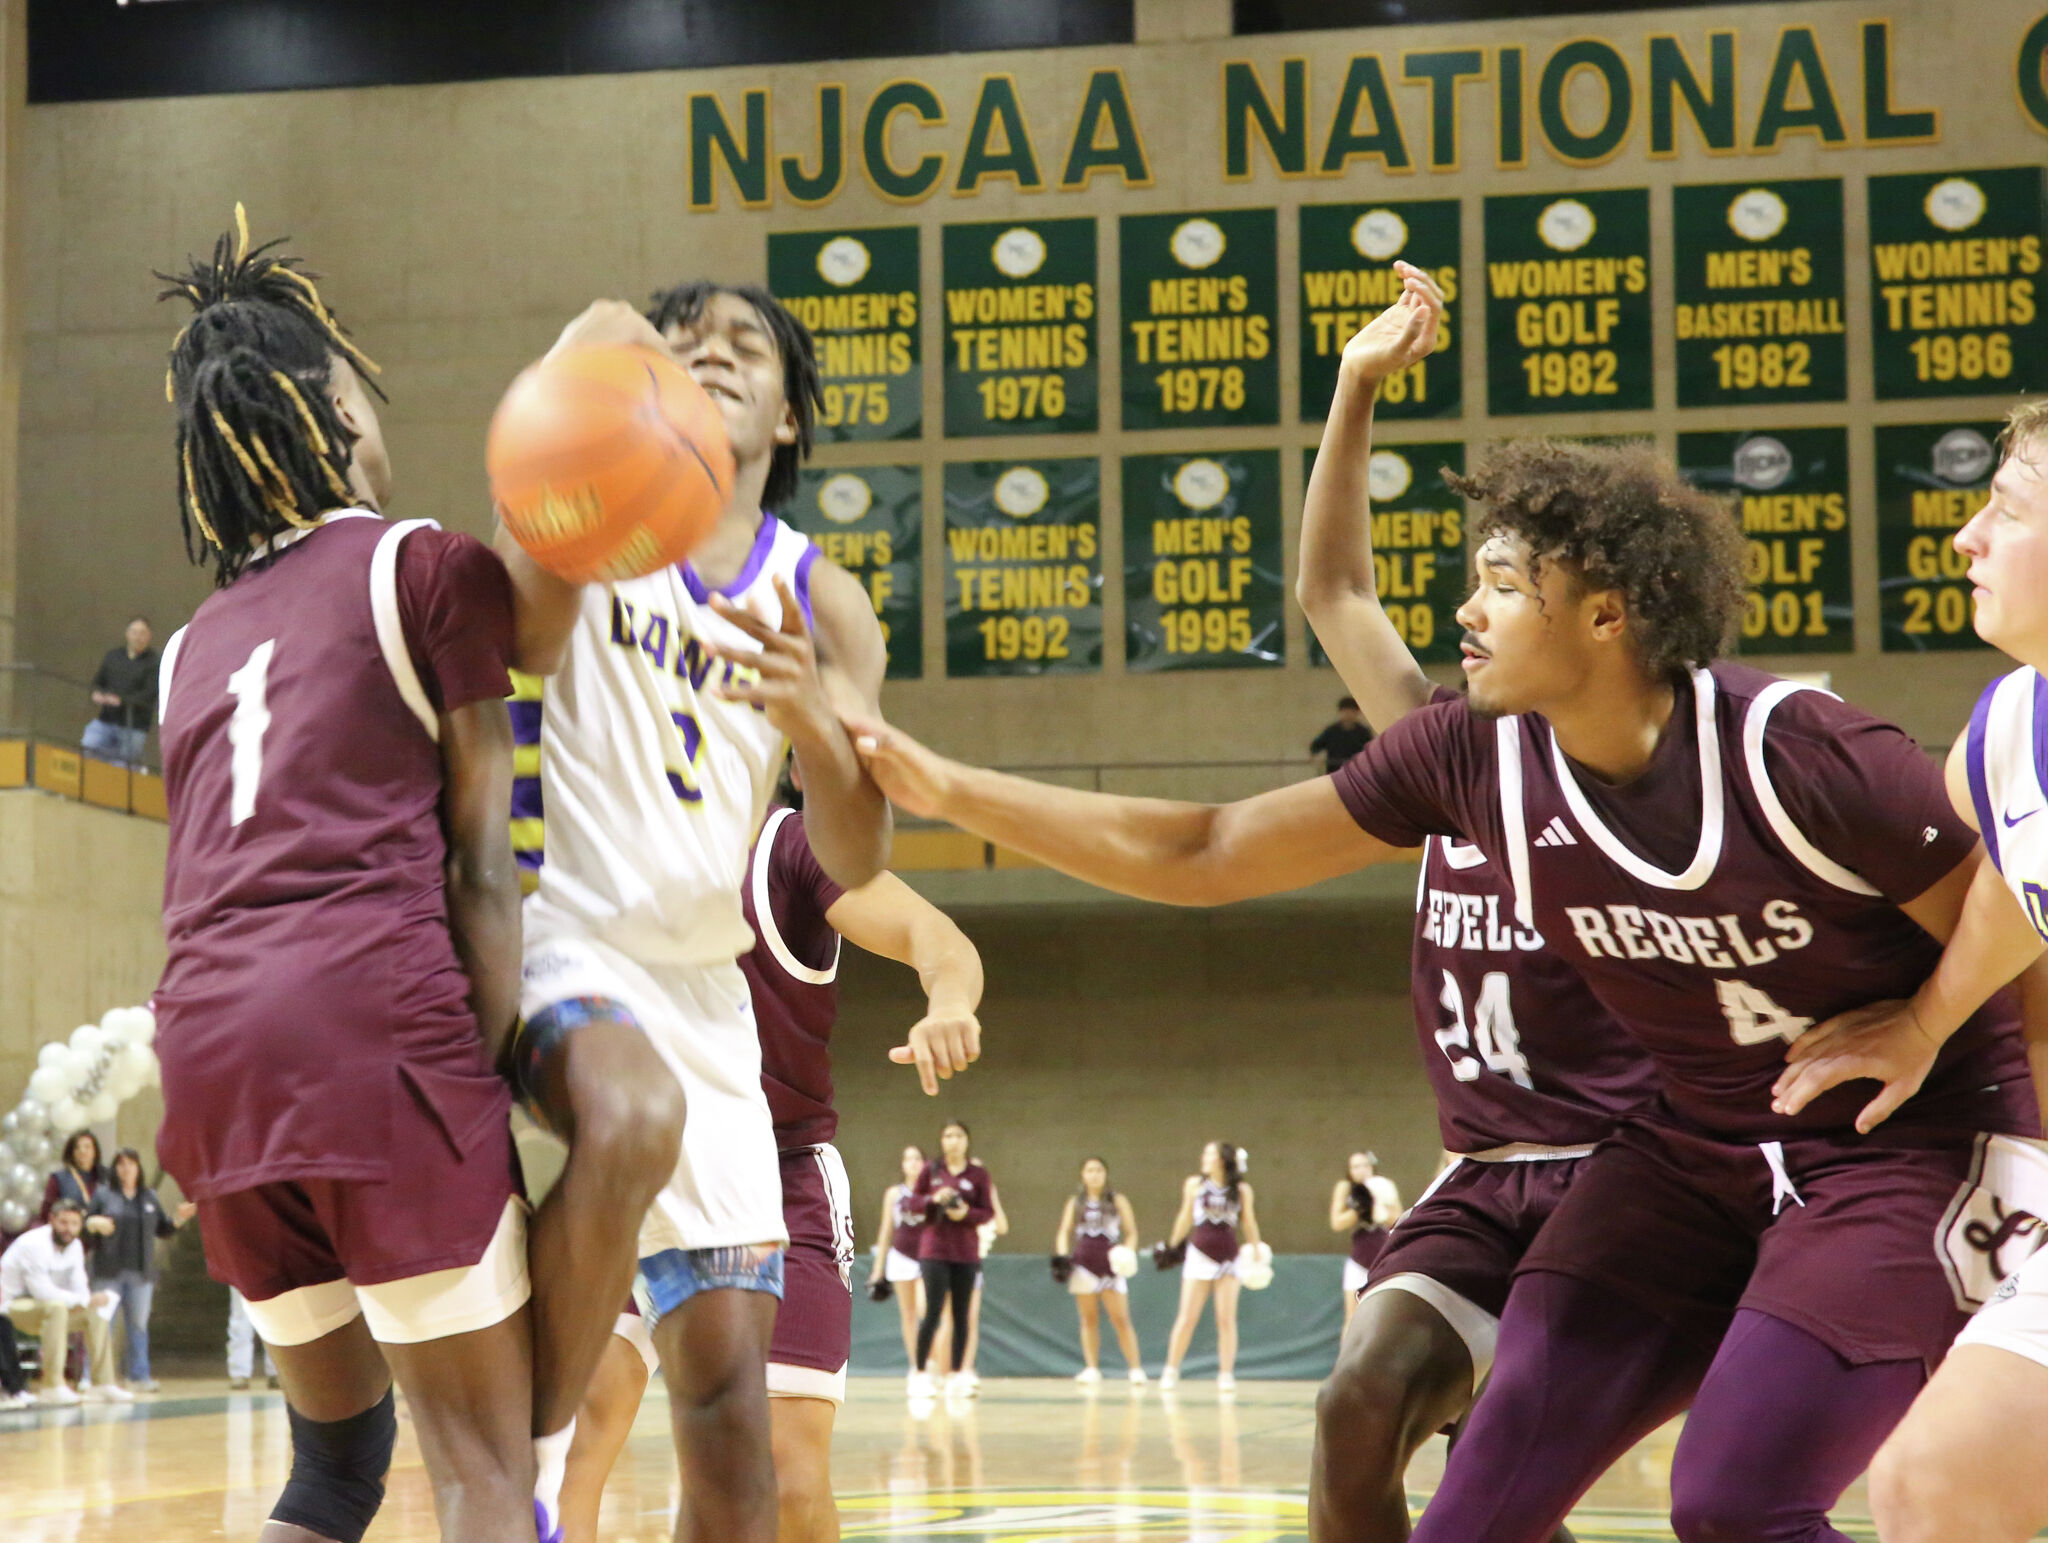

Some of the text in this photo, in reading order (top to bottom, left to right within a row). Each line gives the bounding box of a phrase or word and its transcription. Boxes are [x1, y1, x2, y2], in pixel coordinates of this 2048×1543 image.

[687, 66, 1155, 212] NJCAA
[1221, 18, 1942, 182] NATIONAL
[1489, 256, 1646, 298] WOMEN'S
[1706, 248, 1811, 288] MEN'S
[1875, 236, 2041, 281] WOMEN'S
[946, 283, 1094, 327] WOMEN'S
[1150, 275, 1248, 315] MEN'S
[1304, 266, 1457, 307] WOMES
[1881, 279, 2035, 330] TENNIS
[1131, 315, 1270, 364] TENNIS
[1516, 299, 1619, 347] GOLF
[1674, 299, 1844, 339] BASKETBALL
[952, 323, 1087, 372] TENNIS
[1713, 342, 1810, 389] 1982
[1910, 333, 2012, 381] 1986
[1156, 366, 1245, 412] 1978
[1522, 350, 1617, 397] 1982
[978, 374, 1066, 420] 1976
[1153, 516, 1251, 555] MEN'S
[1369, 509, 1462, 548] MEN'S
[1741, 493, 1845, 532] MEN'S
[948, 522, 1097, 561] WOMEN'S
[1741, 539, 1824, 585] OLF
[1908, 534, 1972, 581] GO
[956, 564, 1091, 611] TENNIS
[1153, 557, 1252, 605] GOLF
[1372, 552, 1435, 599] OLF
[1159, 608, 1252, 654] 1995
[1385, 603, 1434, 648] 99
[1739, 591, 1828, 637] 001
[1903, 587, 1975, 634] 20
[978, 615, 1070, 660] 1992
[226, 638, 275, 827] 1
[1564, 899, 1815, 969] REBELS
[1713, 978, 1816, 1047] 4
